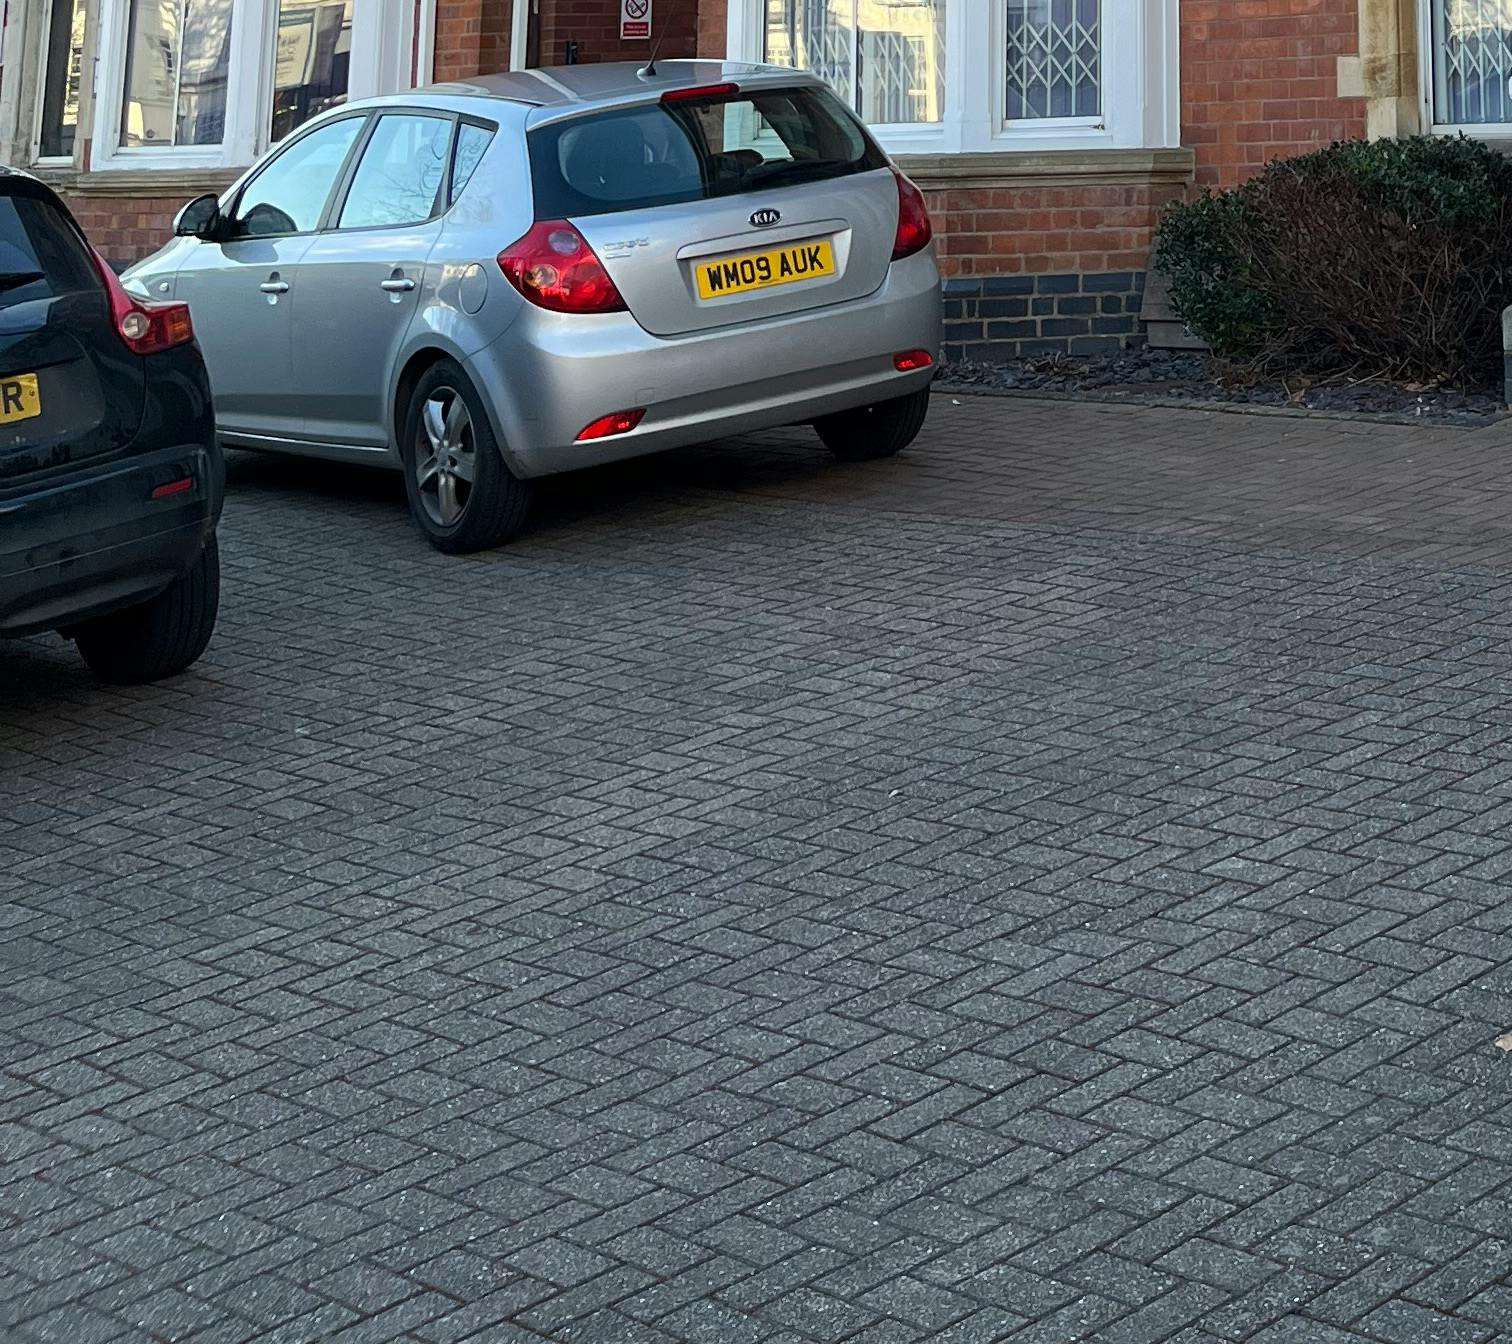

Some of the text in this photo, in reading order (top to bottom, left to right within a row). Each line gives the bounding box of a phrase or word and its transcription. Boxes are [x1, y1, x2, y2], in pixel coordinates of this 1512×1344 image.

[753, 212, 778, 224] KIA
[706, 245, 824, 292] WM09 AUK
